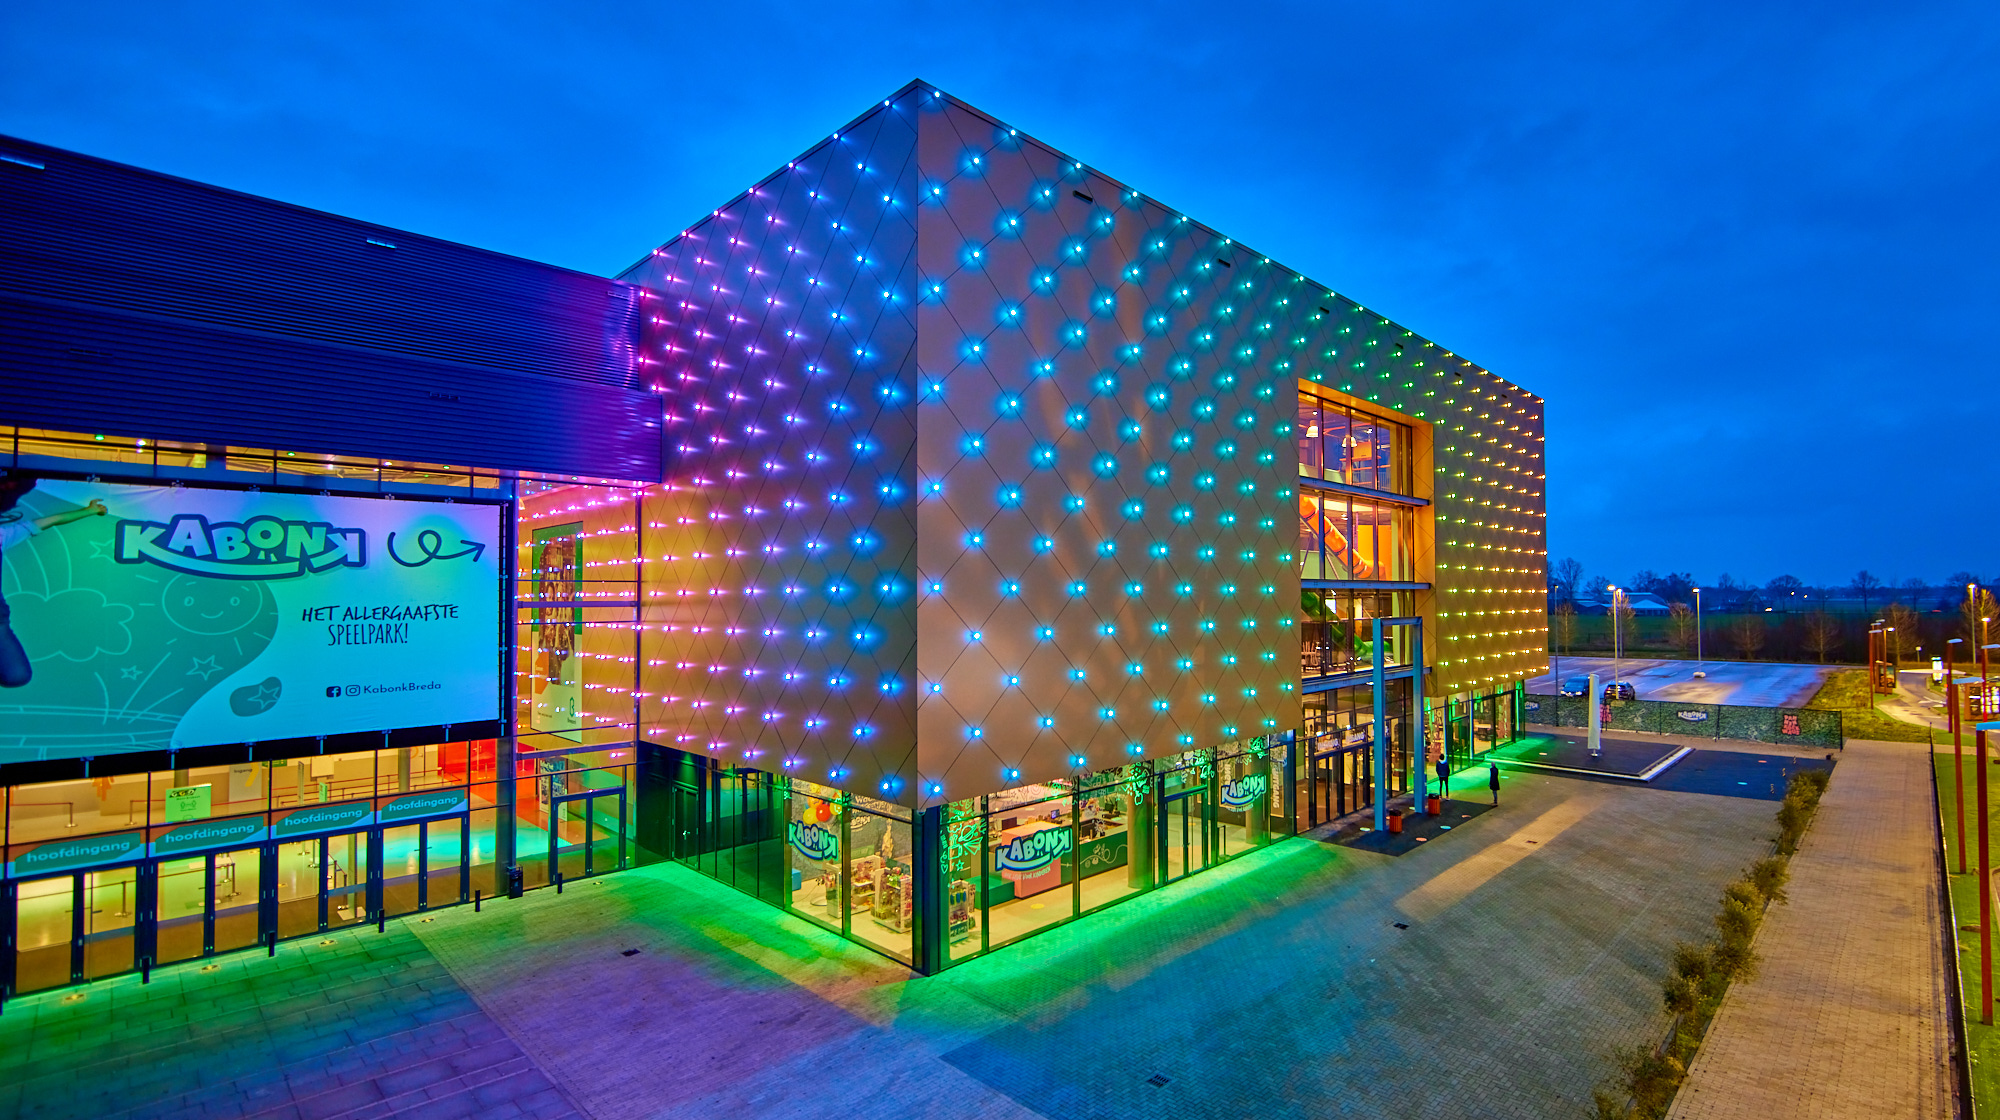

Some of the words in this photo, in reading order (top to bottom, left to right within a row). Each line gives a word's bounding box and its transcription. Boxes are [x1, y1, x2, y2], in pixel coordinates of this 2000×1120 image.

[118, 516, 364, 578] KABONK
[302, 604, 340, 622] HET
[343, 603, 459, 622] ALLERGAAFSTE
[327, 622, 409, 646] SPEELPARK!
[363, 680, 442, 694] KabonkBreda
[1221, 775, 1265, 803] KABONK
[389, 796, 458, 812] hoofdingang
[284, 809, 363, 826] hoofdingang
[165, 823, 255, 844] hoofdingang
[788, 822, 837, 859] KABONK
[26, 841, 130, 863] hoofdingang
[995, 829, 1070, 870] KABONK
